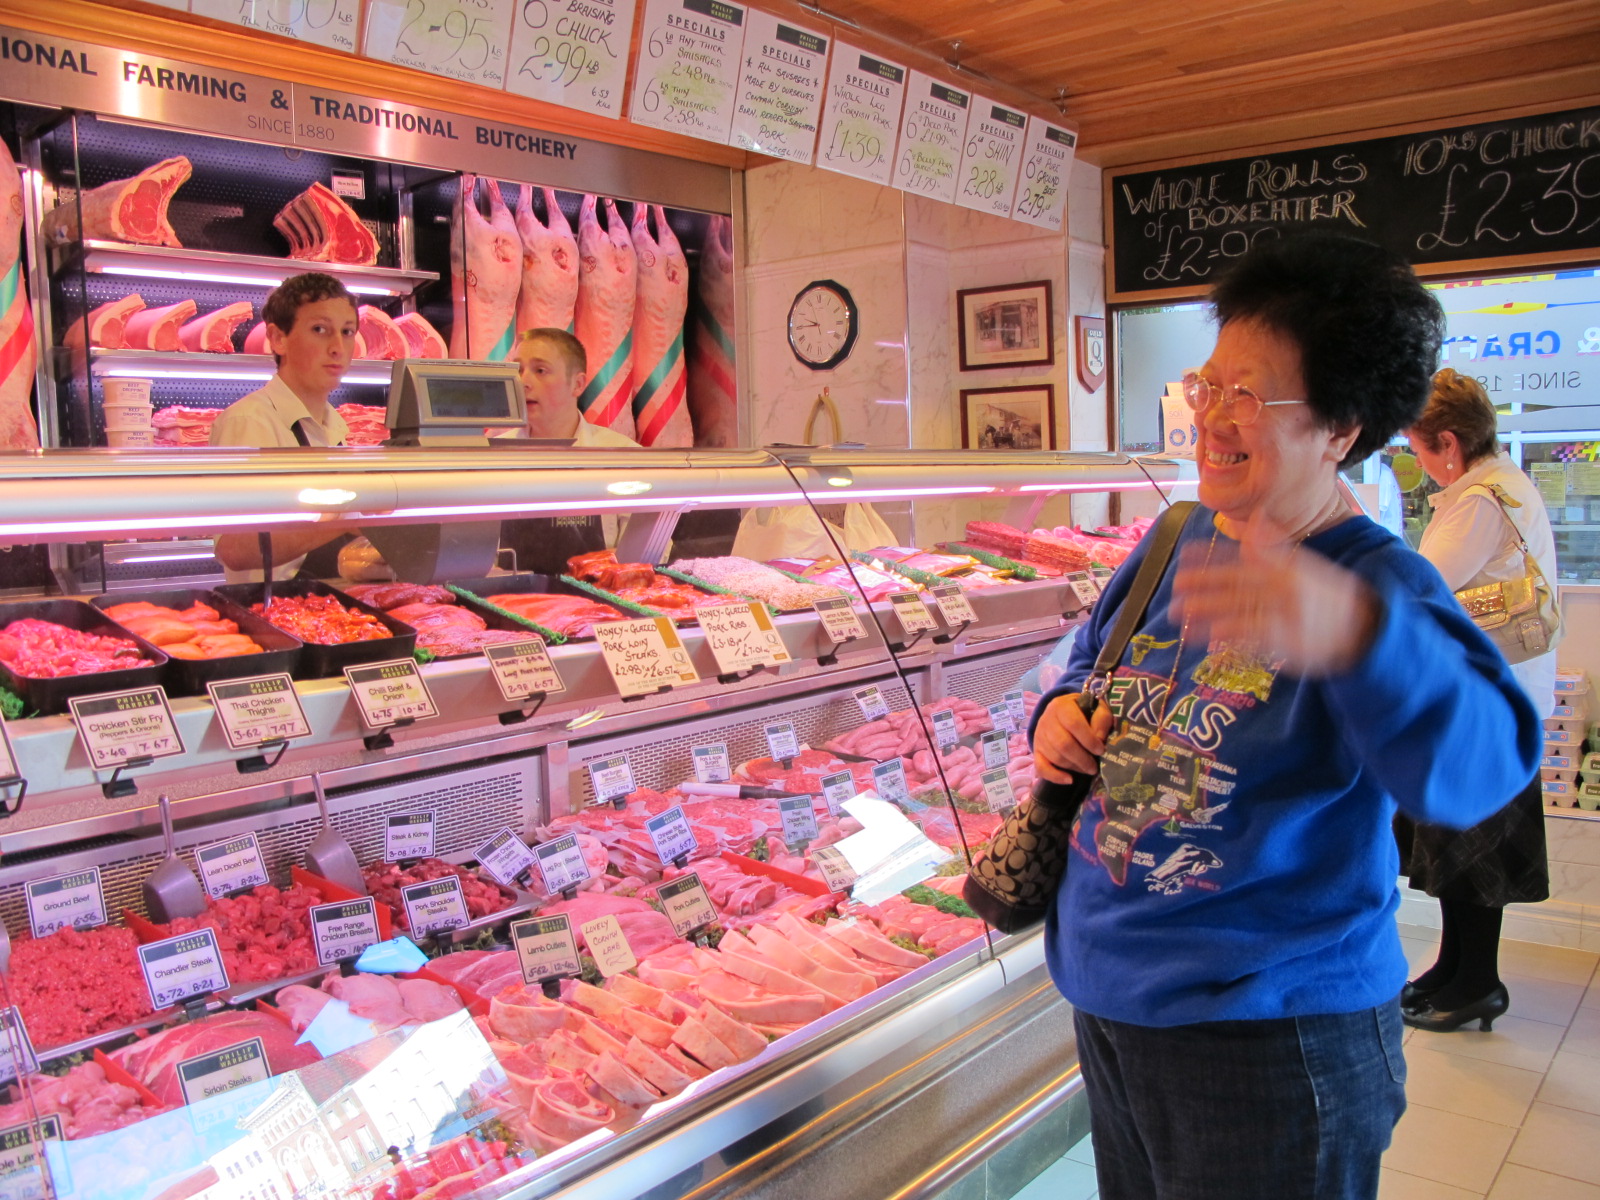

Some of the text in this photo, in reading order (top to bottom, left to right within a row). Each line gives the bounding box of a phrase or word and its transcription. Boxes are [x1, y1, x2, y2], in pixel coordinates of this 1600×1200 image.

[566, 0, 616, 25] BRAISING
[711, 3, 733, 13] PHILIP
[667, 14, 726, 40] SPECIALS
[556, 17, 618, 58] CHUCK
[679, 34, 696, 48] ANY
[700, 41, 726, 56] THICK
[678, 47, 722, 68] SAUSAGES
[762, 45, 811, 68] SPECIALS
[586, 59, 600, 75] LB
[758, 61, 810, 86] ALL SAUSAGES
[672, 85, 690, 98] THIN
[744, 75, 764, 88] MADE
[768, 82, 781, 92] BY
[782, 87, 815, 102] OURSELVES
[846, 75, 890, 97] SPECIALS
[745, 92, 774, 105] CONTAIN
[834, 85, 861, 104] WHOLE
[123, 61, 247, 103] FARMING
[270, 89, 289, 110] &
[310, 95, 459, 140] TRADITIONAL
[475, 126, 578, 160] BUTCHERY
[841, 102, 870, 121] CORNISH
[920, 101, 956, 121] SPECIALS
[247, 115, 335, 142] SINCE 1880
[980, 123, 1014, 140] SPECIALS
[985, 140, 1015, 167] SHIN
[1036, 142, 1065, 160] SPECIALS
[1045, 158, 1060, 173] PURE
[1121, 154, 1368, 217] WHOLE ROLLS
[1144, 190, 1367, 243] of BOXEATER
[707, 622, 728, 632] PORK
[603, 638, 648, 652] PORK LOIN
[380, 665, 408, 673] PHILIP
[383, 670, 411, 678] WARREN
[250, 680, 281, 688] PHILIP
[251, 686, 284, 694] WARREN
[369, 686, 387, 695] Chilli
[387, 684, 405, 692] Beef
[117, 694, 152, 704] PHILIP
[230, 697, 285, 710] Thai Chicken
[383, 693, 405, 701] Onion
[118, 700, 155, 710] WARREN
[247, 706, 276, 716] Thighs
[89, 714, 164, 733] Chicken Stir Fry
[1157, 761, 1180, 772] DALLAS
[1200, 757, 1237, 775] TEXARKANA
[1170, 774, 1186, 785] TYLER
[1116, 804, 1140, 818] AUSTIN
[1180, 821, 1223, 831] GALVESTON
[658, 830, 673, 839] Chinese
[667, 833, 678, 841] Spare
[225, 839, 249, 850] PHILIP
[487, 841, 516, 863] Frozen Chicken
[1134, 850, 1155, 861] PADRE
[207, 856, 256, 876] Lean Diced Beef
[565, 855, 580, 864] Steaks
[1132, 857, 1155, 868] ISLAND
[62, 874, 90, 884] PHILIP
[62, 879, 91, 889] WARREN
[430, 882, 452, 890] PHILIP
[677, 878, 694, 887] PHILIP
[44, 894, 90, 911] Ground Beef
[415, 897, 456, 911] Pork Shoulder
[685, 897, 700, 906] Cutlets
[342, 909, 368, 917] WARREN
[427, 906, 448, 915] Steaks
[344, 922, 365, 930] Range
[540, 920, 562, 928] PHILIP
[585, 920, 609, 934] LOVELY
[176, 936, 204, 947] PHILIP
[321, 927, 374, 942] Chicken Breasts
[176, 941, 206, 953] WARREN
[527, 941, 567, 955] Lamb Cutlets
[603, 943, 620, 955] LAMB
[154, 957, 213, 979] Chandler Steak
[220, 1046, 251, 1061] PHILIP
[221, 1053, 254, 1067] WARREN
[204, 1075, 252, 1096] Sirloin Steaks
